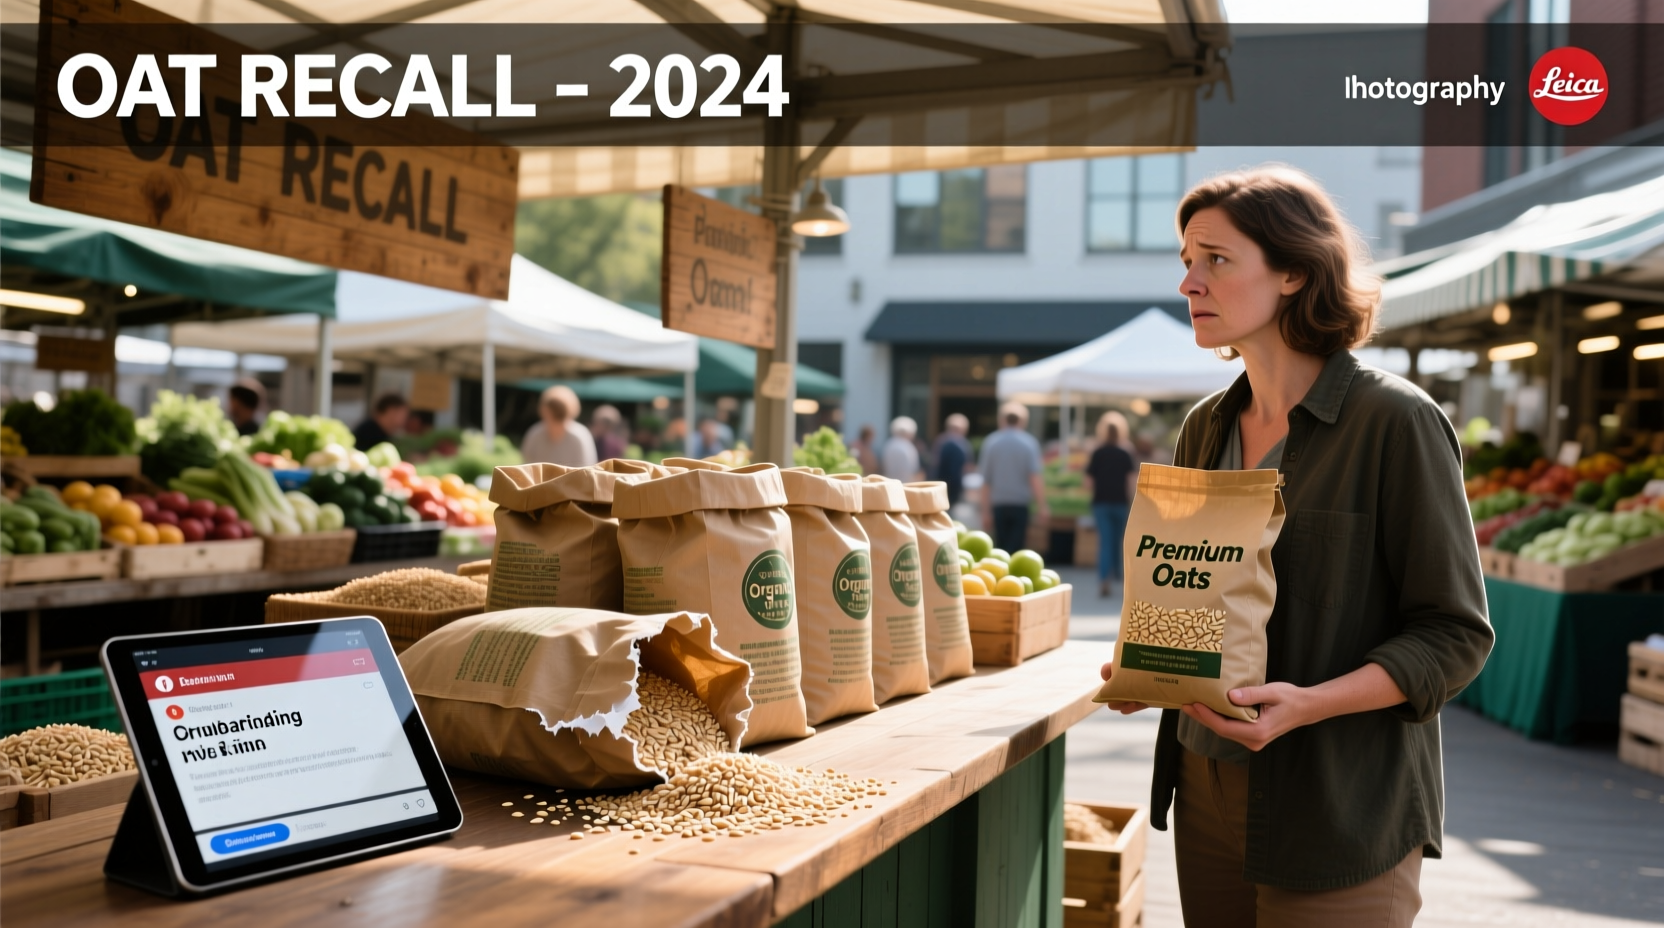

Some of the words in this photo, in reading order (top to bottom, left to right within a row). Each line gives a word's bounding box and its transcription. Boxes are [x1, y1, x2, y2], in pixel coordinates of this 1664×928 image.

[280, 120, 468, 245] RECALL
[1136, 534, 1244, 563] Premium
[1152, 562, 1212, 590] Oats
